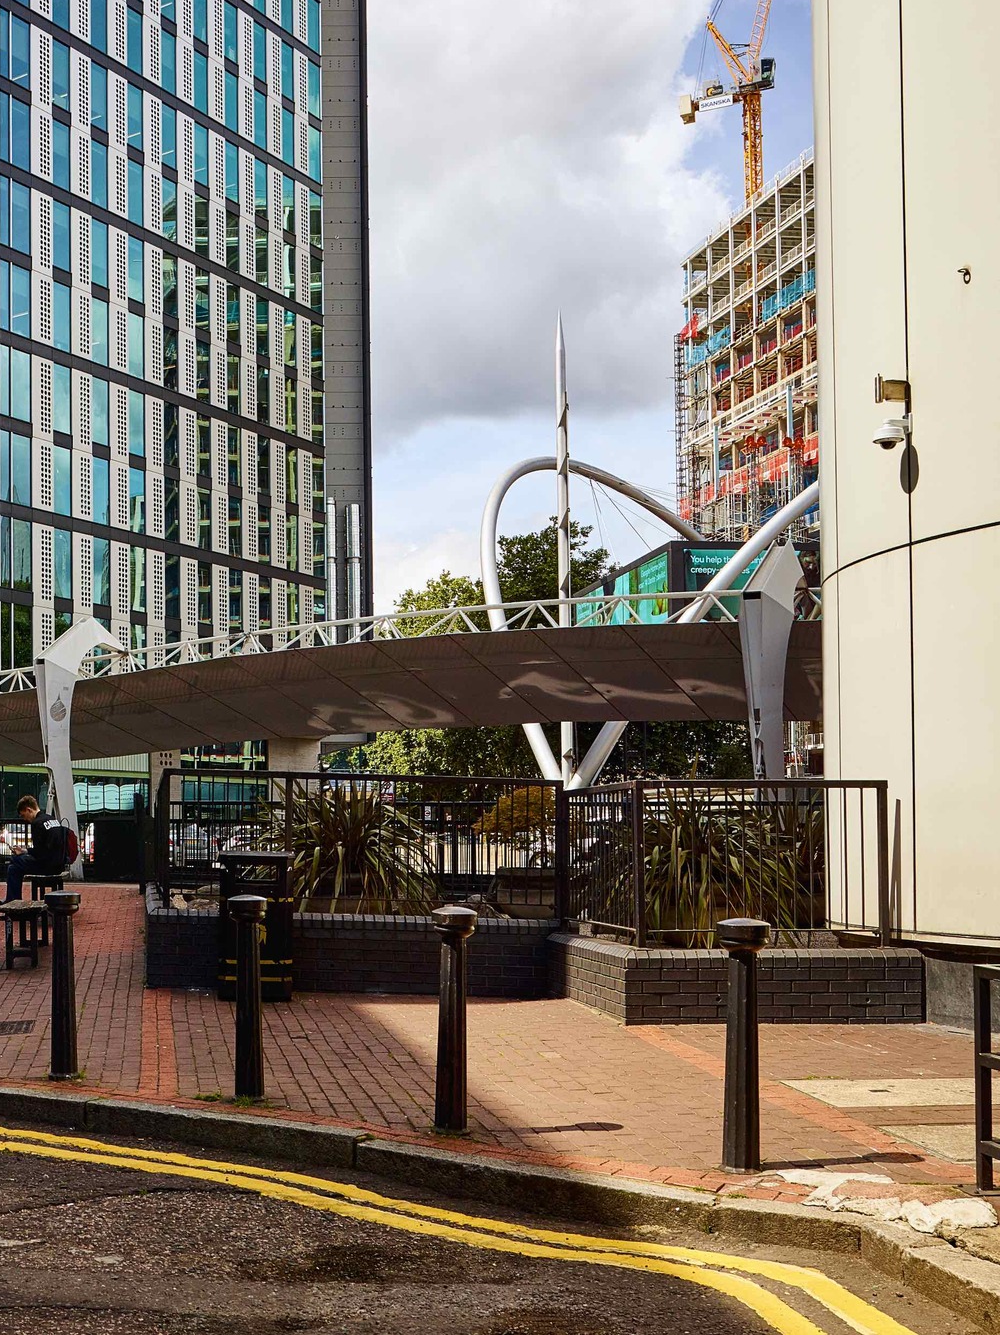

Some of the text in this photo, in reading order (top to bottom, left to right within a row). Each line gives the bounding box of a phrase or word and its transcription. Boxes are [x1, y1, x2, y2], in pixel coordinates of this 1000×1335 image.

[701, 98, 731, 109] SKANSKA
[690, 555, 705, 563] You
[706, 555, 723, 565] help
